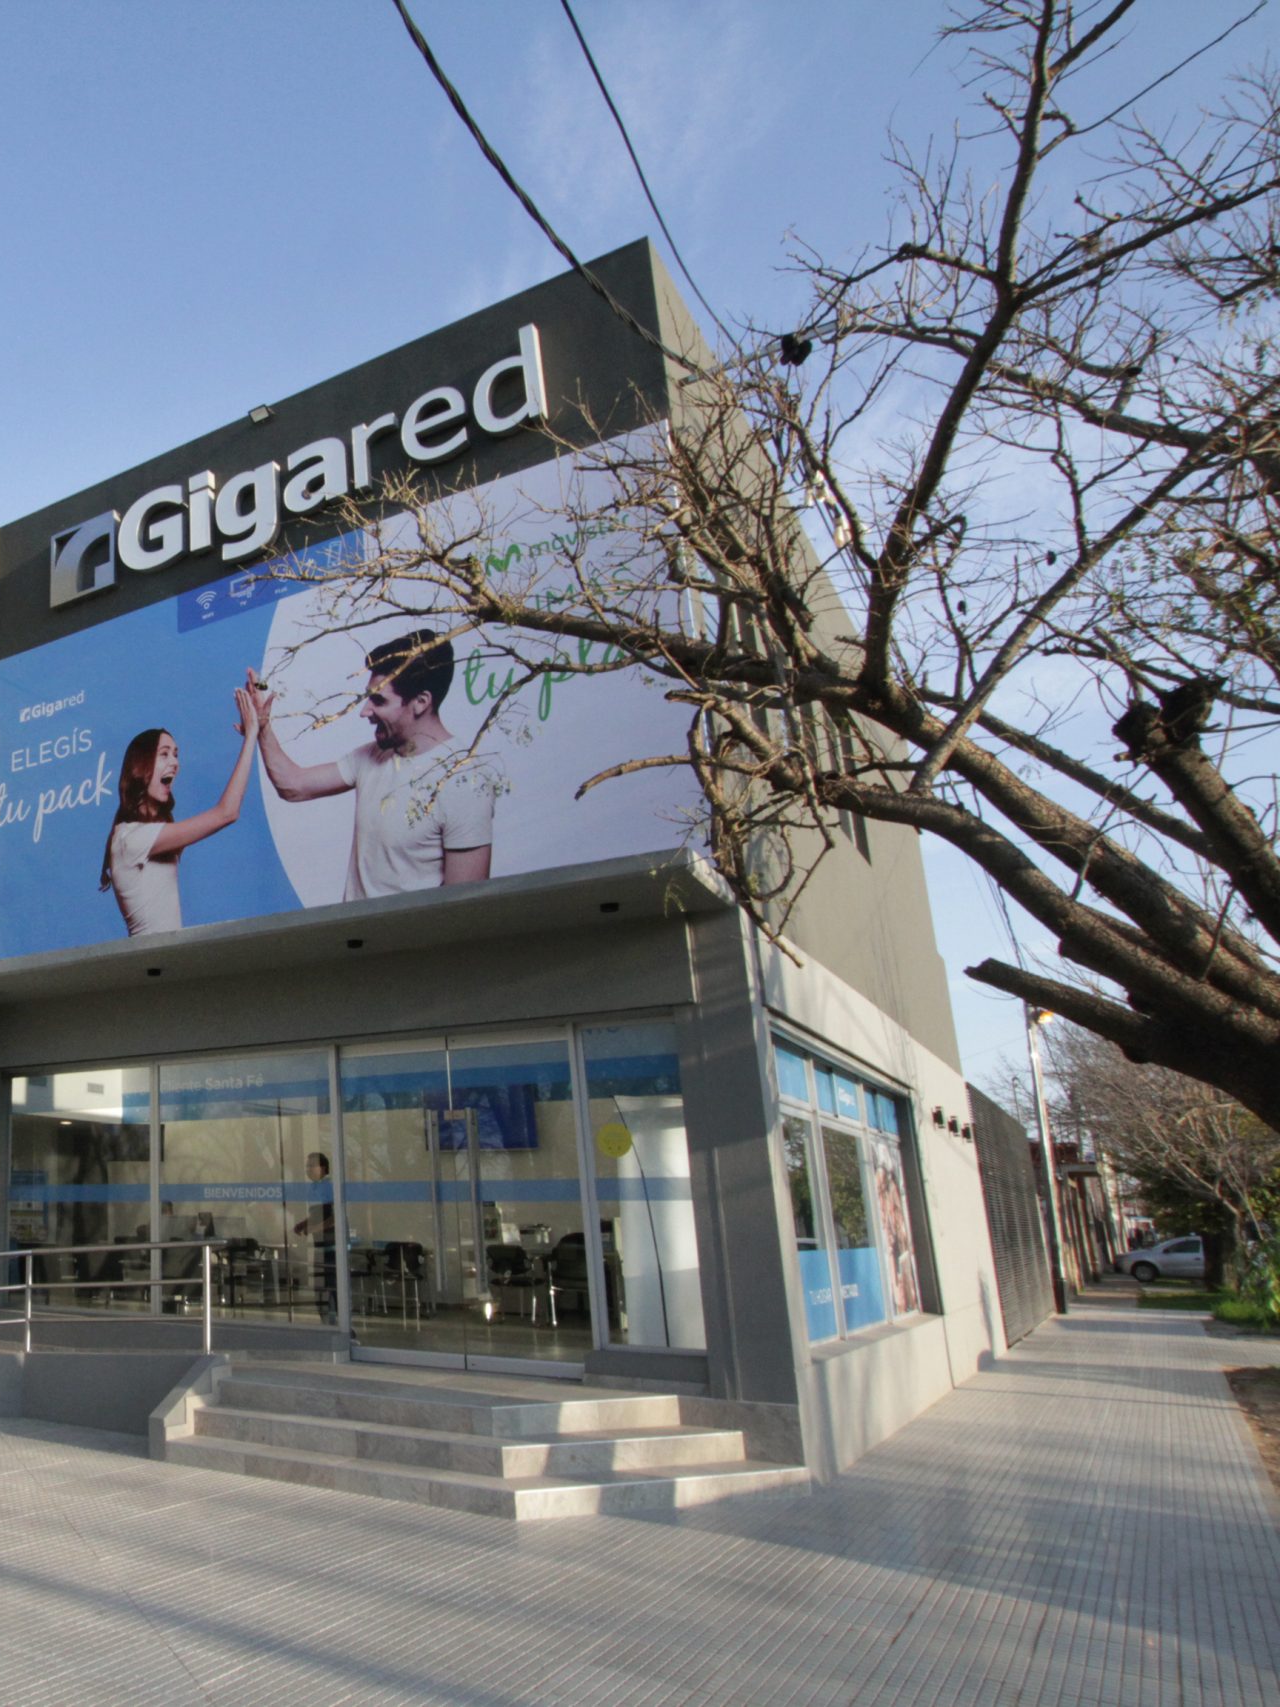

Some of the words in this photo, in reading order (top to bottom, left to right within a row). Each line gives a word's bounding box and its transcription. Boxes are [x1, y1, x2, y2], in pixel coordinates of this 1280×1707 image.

[117, 322, 549, 573] Gigared
[31, 690, 86, 718] Gigared
[11, 728, 93, 773] ELEGÍS
[33, 751, 113, 843] pack
[205, 1076, 243, 1091] Santa
[203, 1186, 283, 1199] BIENVENIDOS
